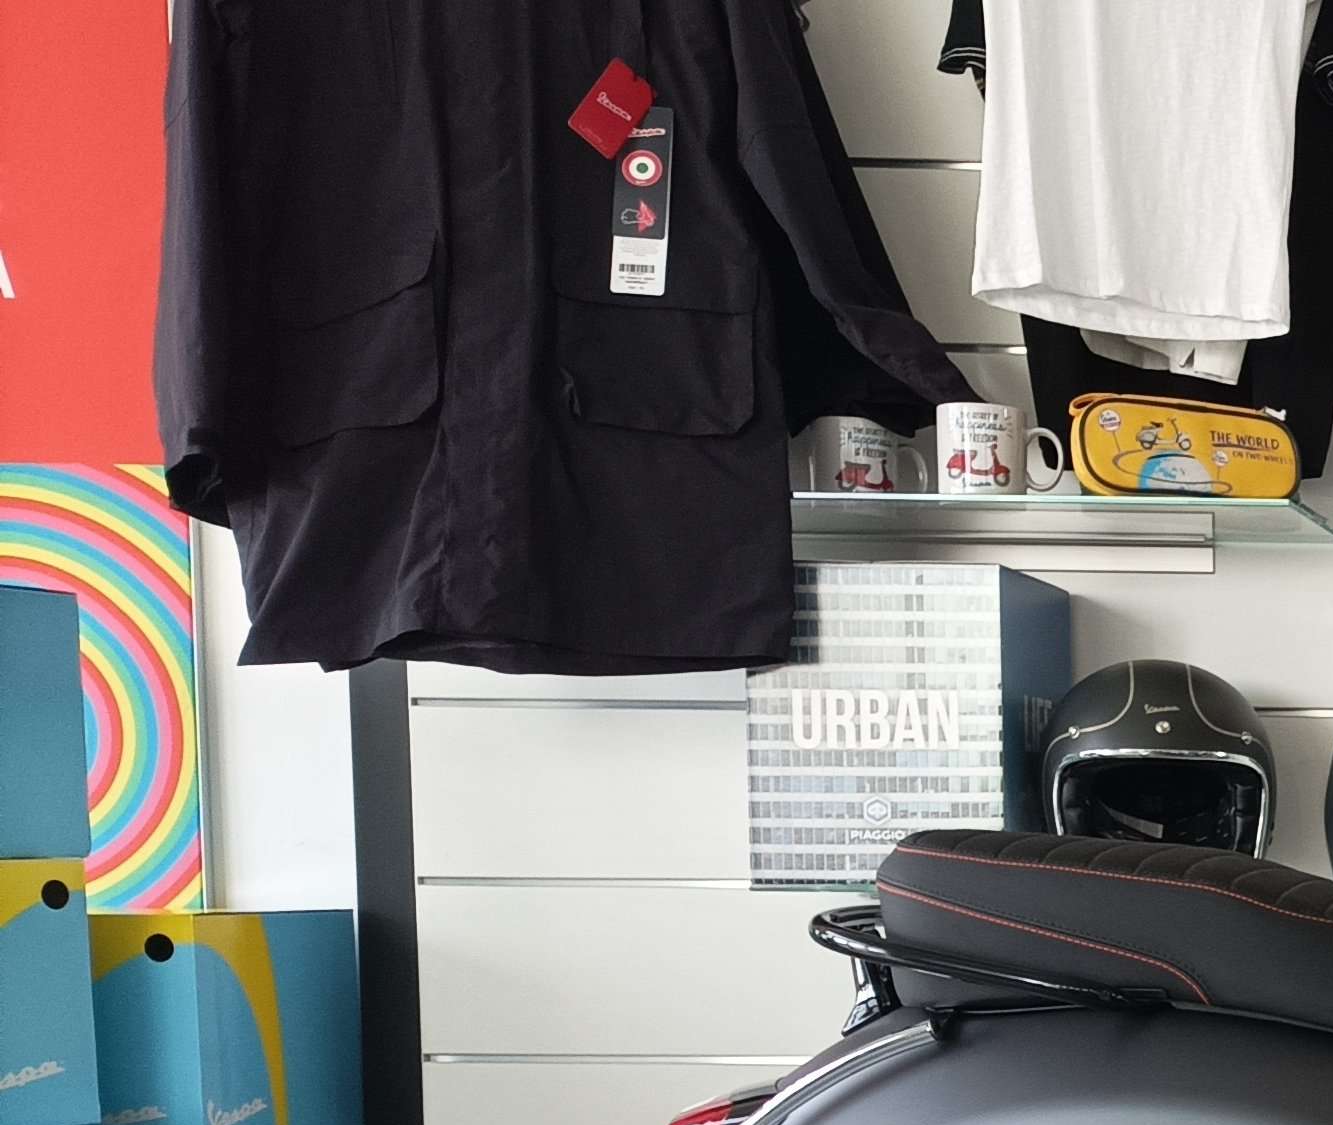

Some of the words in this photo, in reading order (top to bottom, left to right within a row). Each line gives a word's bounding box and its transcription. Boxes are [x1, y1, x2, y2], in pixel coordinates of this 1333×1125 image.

[1209, 430, 1232, 444] THE
[1236, 434, 1280, 450] WORLD
[791, 689, 960, 751] URBAN
[850, 830, 905, 841] PIAGGIO
